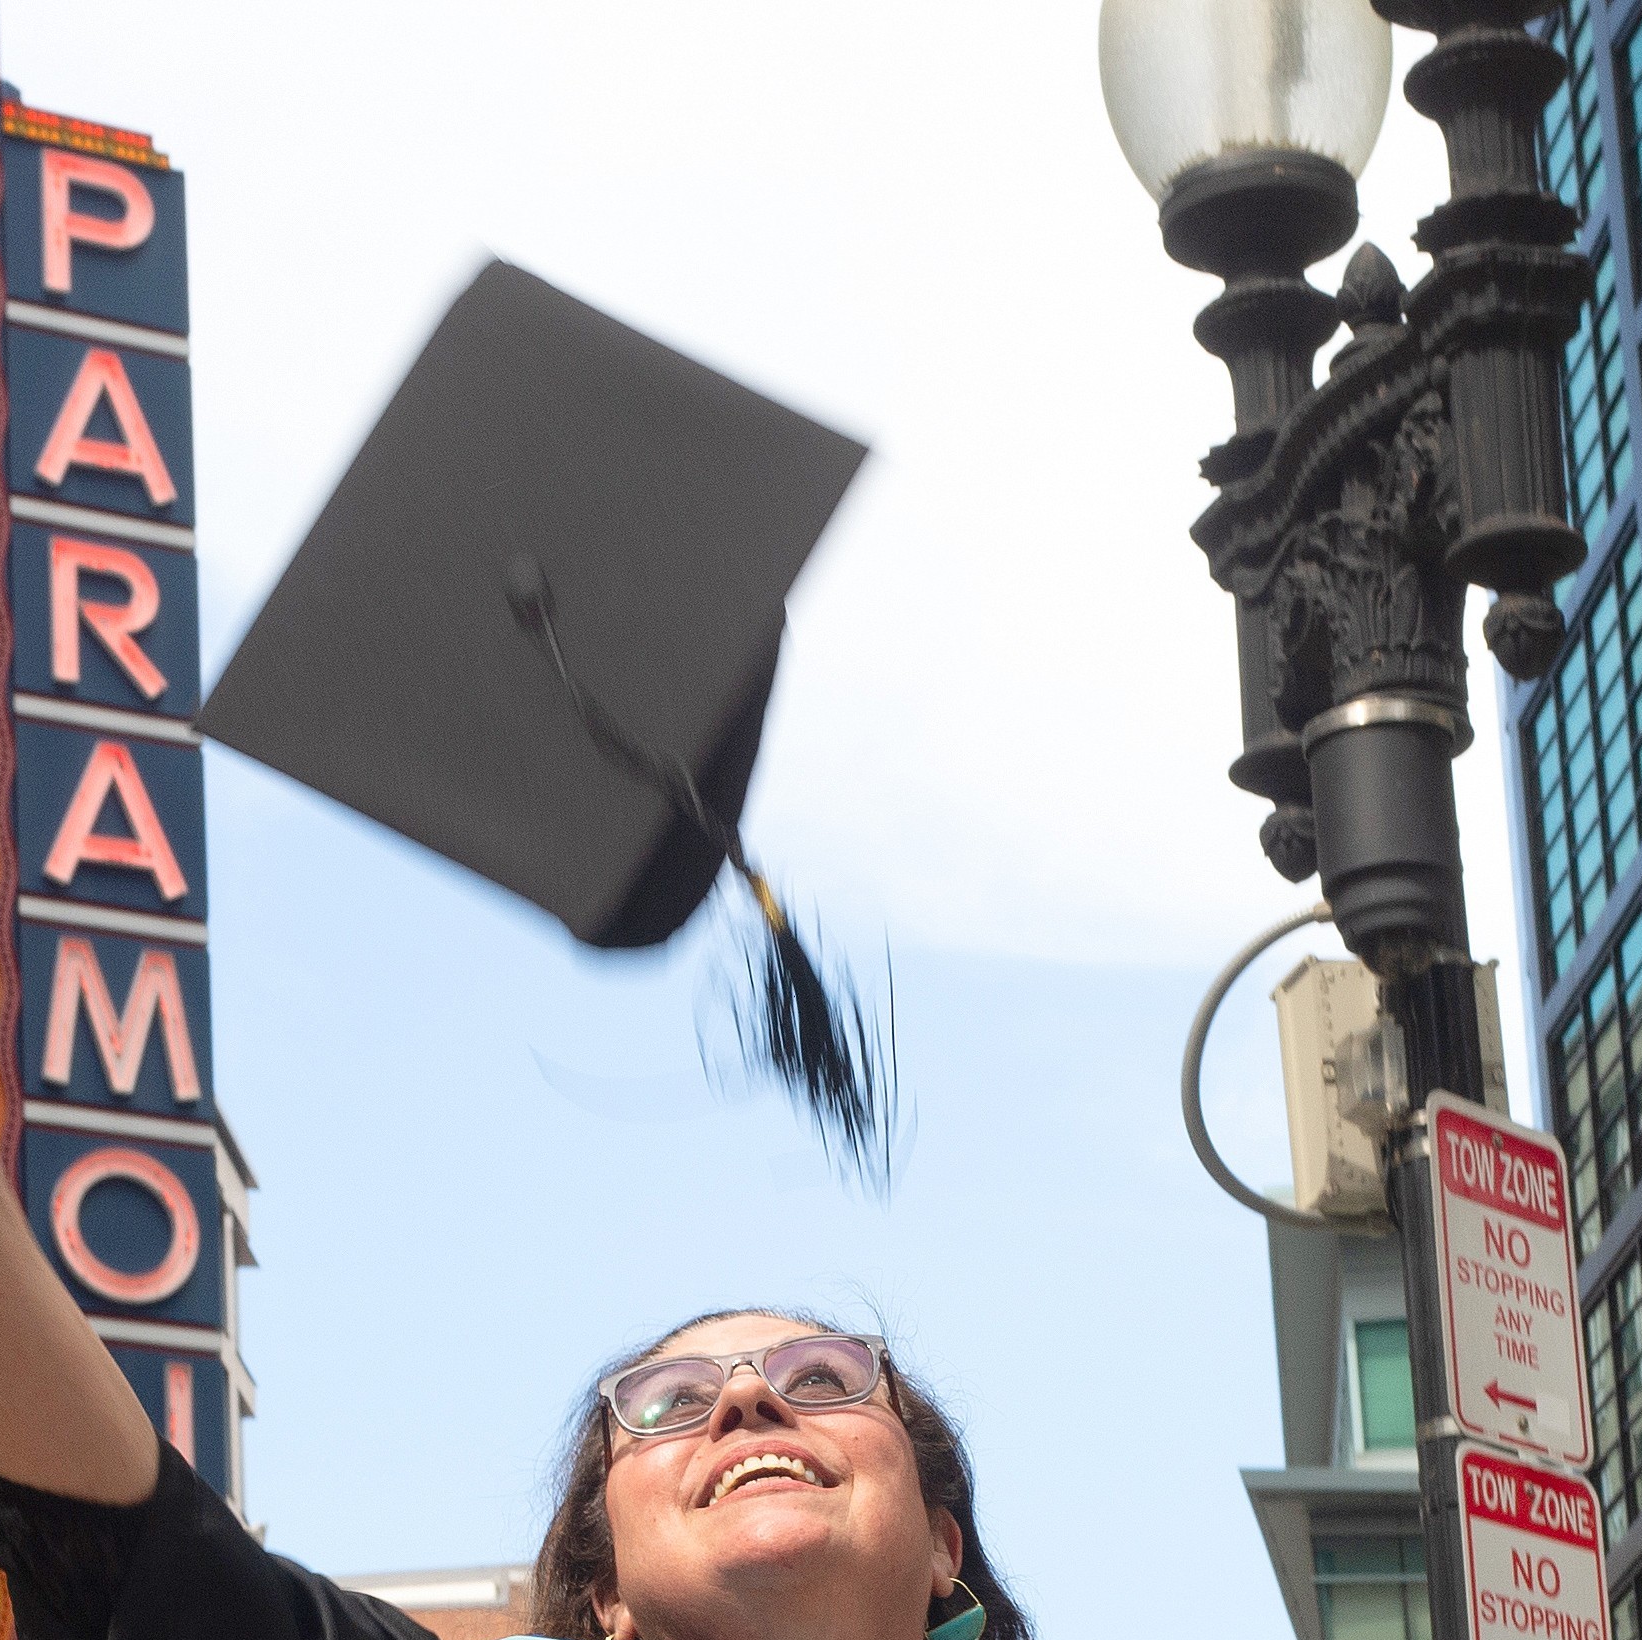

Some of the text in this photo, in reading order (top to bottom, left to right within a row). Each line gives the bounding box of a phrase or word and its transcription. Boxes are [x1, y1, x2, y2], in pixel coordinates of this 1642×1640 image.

[1446, 1131, 1560, 1220] TOW ZONE
[1483, 1217, 1531, 1269] NO
[1457, 1257, 1565, 1318] STOPPING
[1495, 1304, 1534, 1336] ANY
[1494, 1332, 1539, 1371] TIME
[1467, 1464, 1593, 1540] TOW ZONE
[1512, 1548, 1561, 1599] NO
